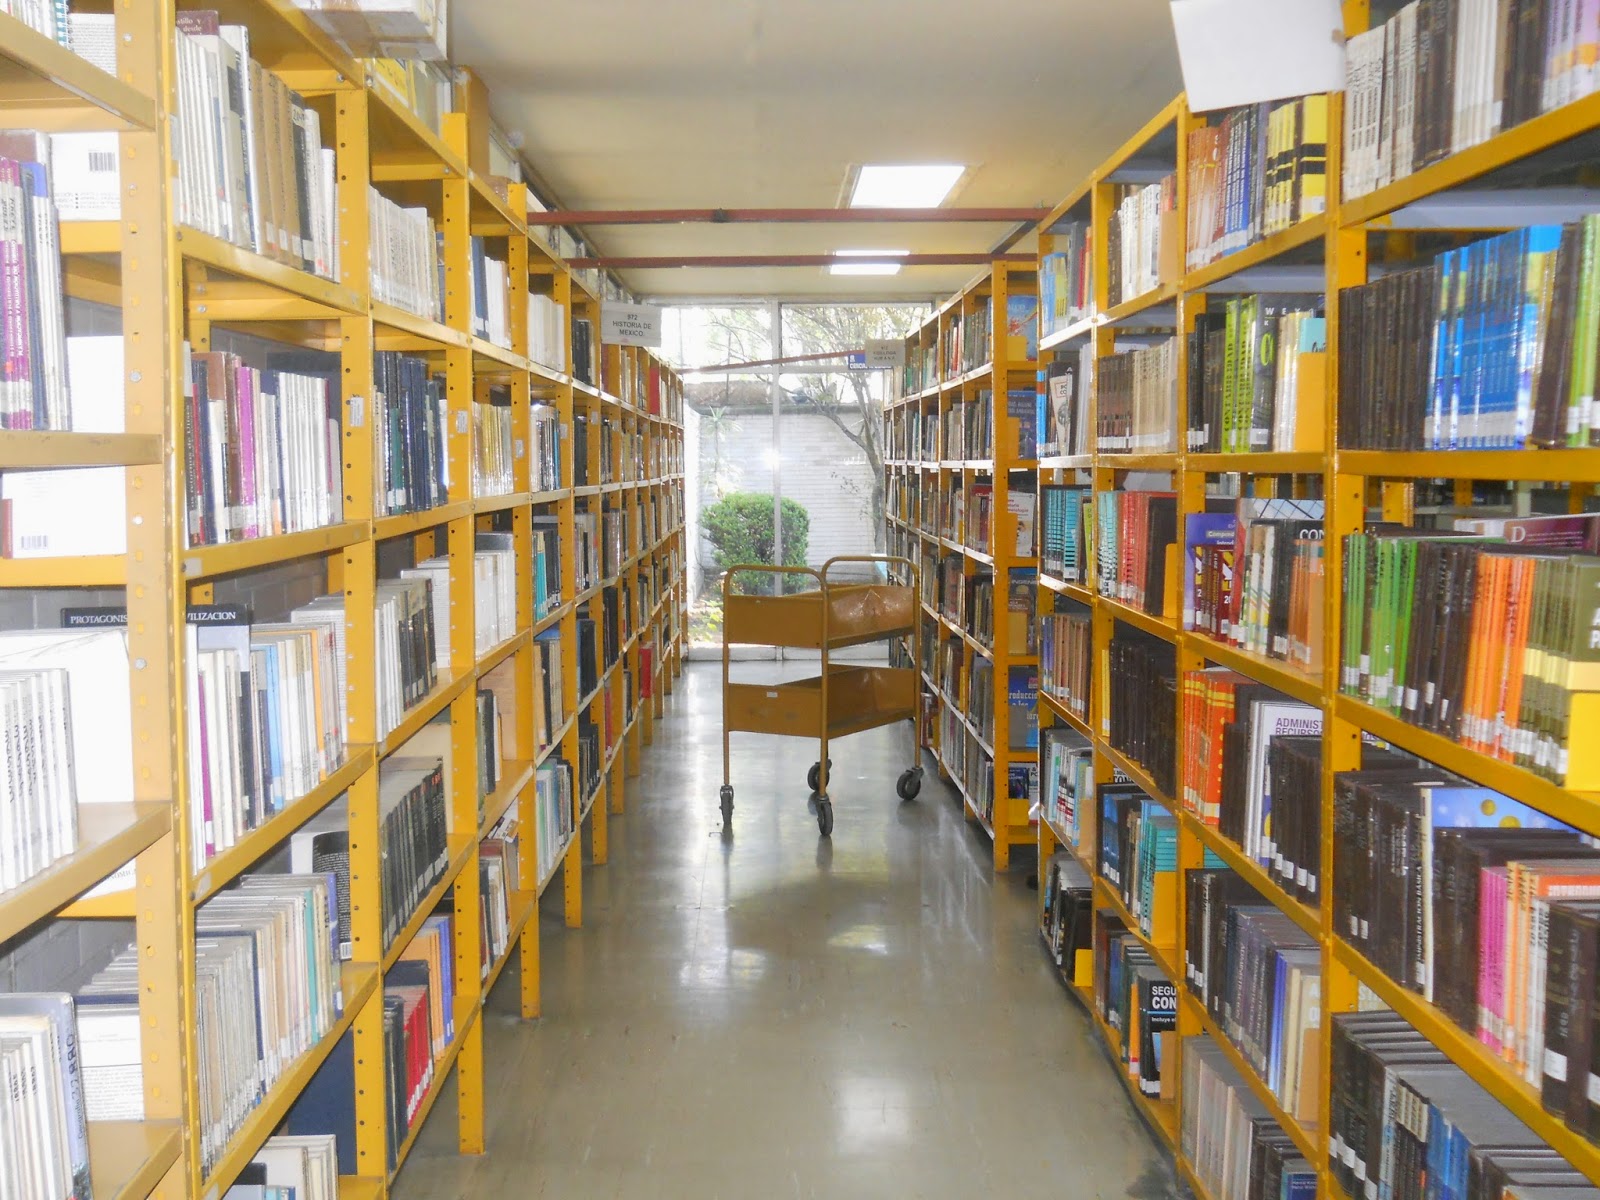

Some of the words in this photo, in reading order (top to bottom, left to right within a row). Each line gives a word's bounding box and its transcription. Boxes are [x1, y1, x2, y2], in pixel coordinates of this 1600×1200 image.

[612, 320, 642, 329] HISTORIA
[643, 322, 652, 330] DE
[1223, 342, 1233, 431] CONTABILIDAD
[1511, 526, 1526, 543] D
[1151, 985, 1177, 996] SEGU
[1151, 996, 1177, 1010] CON
